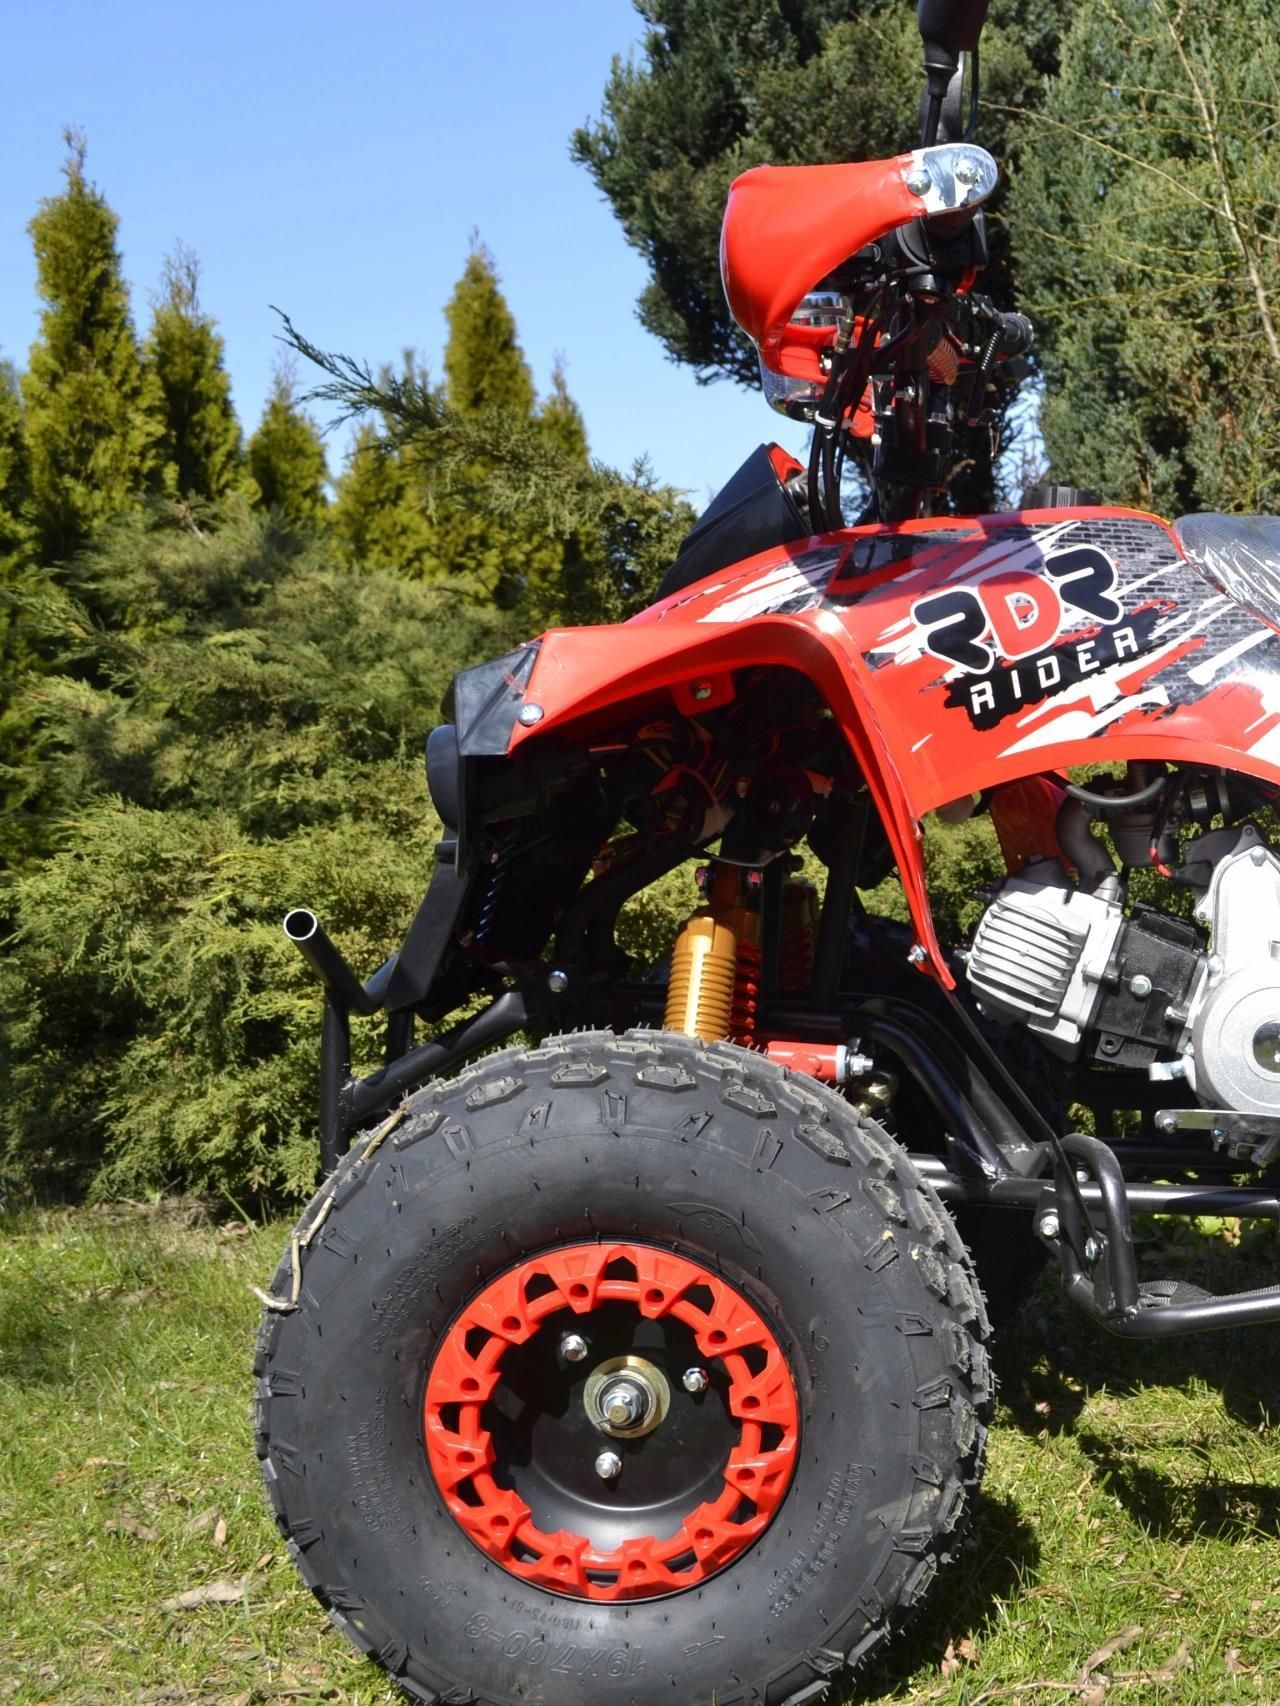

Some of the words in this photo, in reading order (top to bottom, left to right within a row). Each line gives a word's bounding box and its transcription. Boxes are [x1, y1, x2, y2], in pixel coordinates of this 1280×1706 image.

[911, 544, 1124, 674] RDR
[970, 627, 1139, 715] RIDER
[464, 1610, 647, 1677] 19X7.00-8
